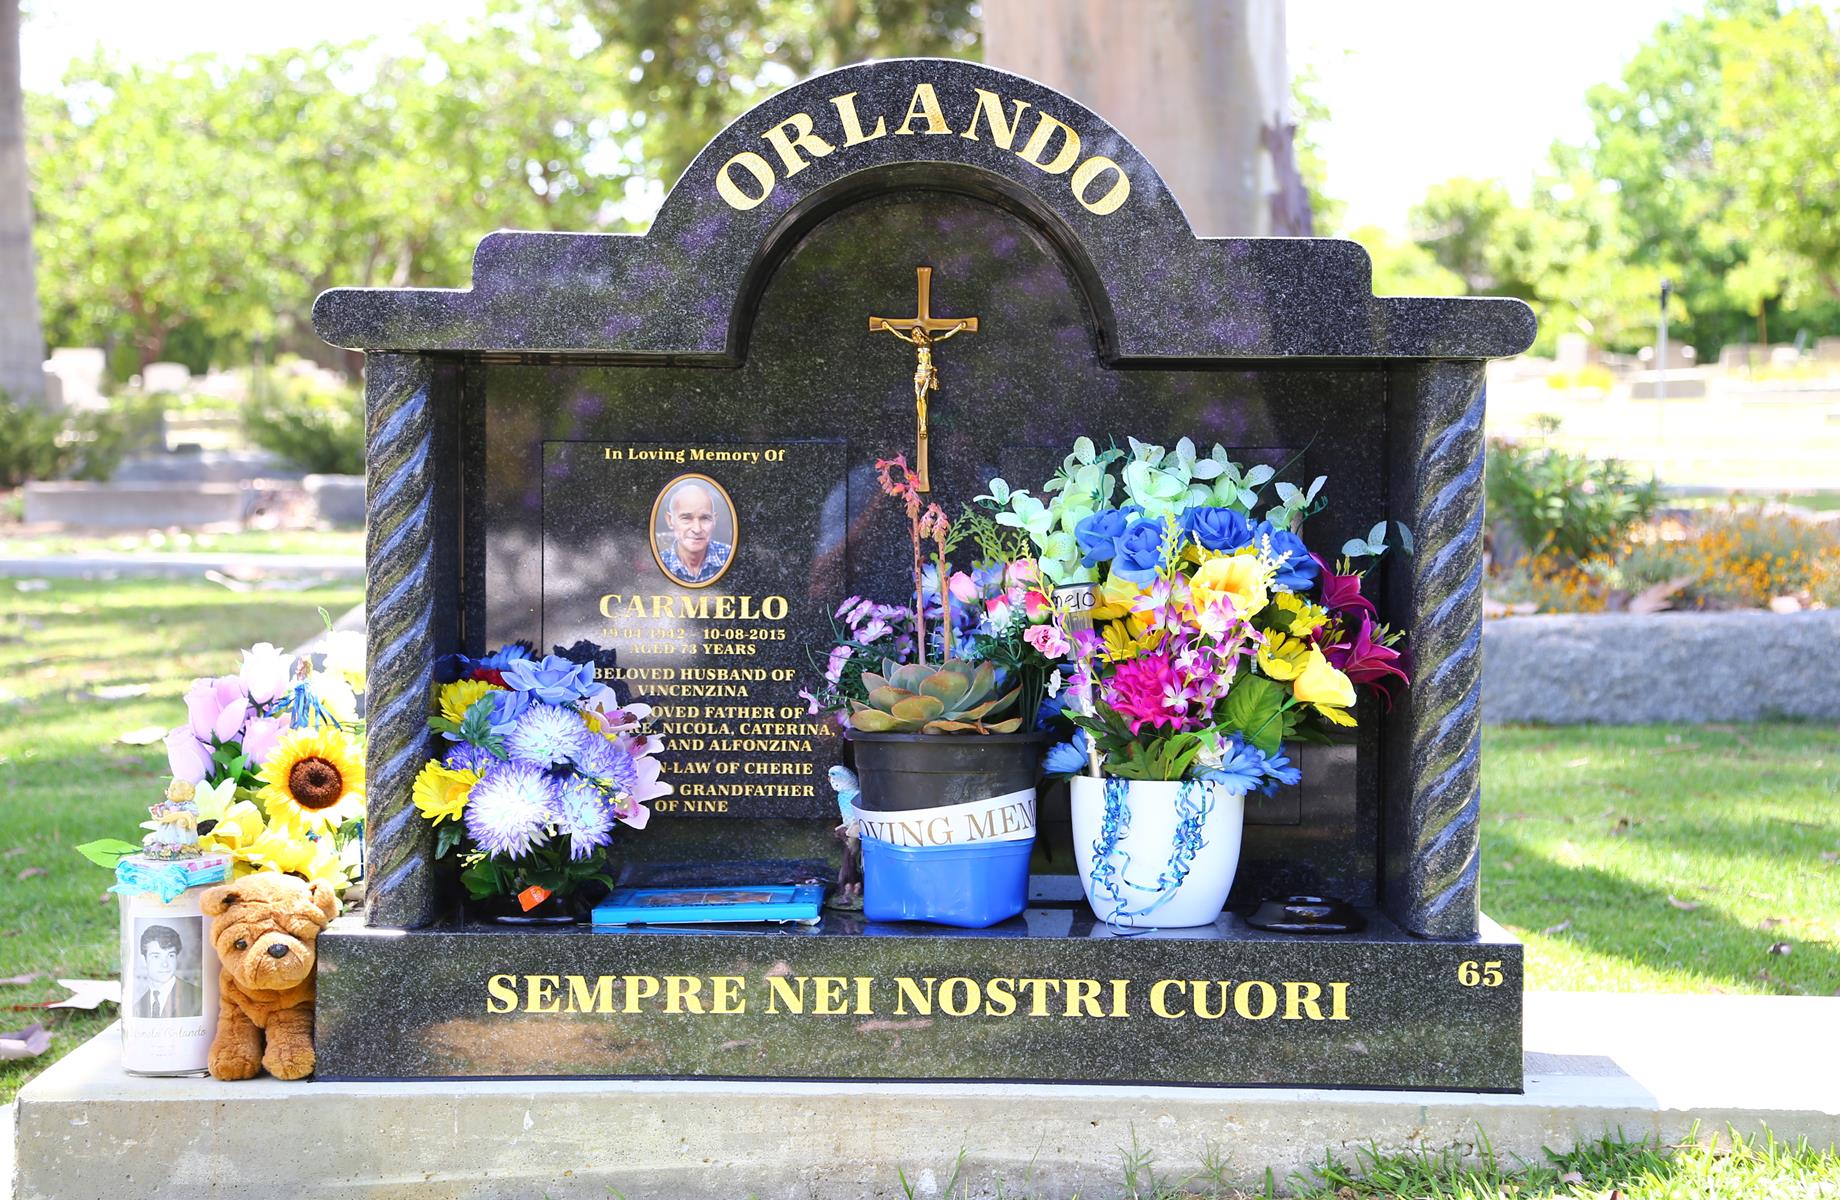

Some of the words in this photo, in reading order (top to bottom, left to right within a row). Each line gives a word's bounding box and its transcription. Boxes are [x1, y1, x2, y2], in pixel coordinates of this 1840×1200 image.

[715, 83, 1131, 216] ORLANDO
[604, 448, 623, 460] In
[628, 448, 685, 463] Loving
[690, 448, 760, 464] Memory
[764, 449, 786, 462] Of
[599, 594, 789, 620] CARMELO
[703, 628, 786, 641] 10-08-2015
[630, 642, 675, 655] AGED
[681, 643, 698, 655] 73
[703, 643, 756, 655] YEARS
[594, 667, 675, 680] BELOVED
[680, 668, 767, 681] HUSBAND
[771, 668, 796, 681] OF
[638, 684, 748, 697] VINCENZINA
[650, 705, 699, 719] OVED
[705, 706, 774, 719] FATHER
[780, 706, 804, 719] OF
[662, 722, 735, 736] NICOLA,
[739, 723, 836, 737] CATERINA,
[667, 739, 704, 752] AND
[710, 739, 812, 752] ALFONZINA
[715, 762, 740, 775] OF
[743, 762, 813, 775] CHERIE
[679, 784, 815, 797] GRANDFATHER
[654, 800, 679, 813] OF
[684, 800, 728, 813] NINE
[964, 798, 1036, 842] MEM
[1457, 960, 1504, 987] 65
[487, 974, 746, 1015] SEMPRE
[765, 975, 874, 1016] NEI
[893, 976, 1131, 1018] NOSTRI
[1149, 979, 1350, 1021] CUORI
